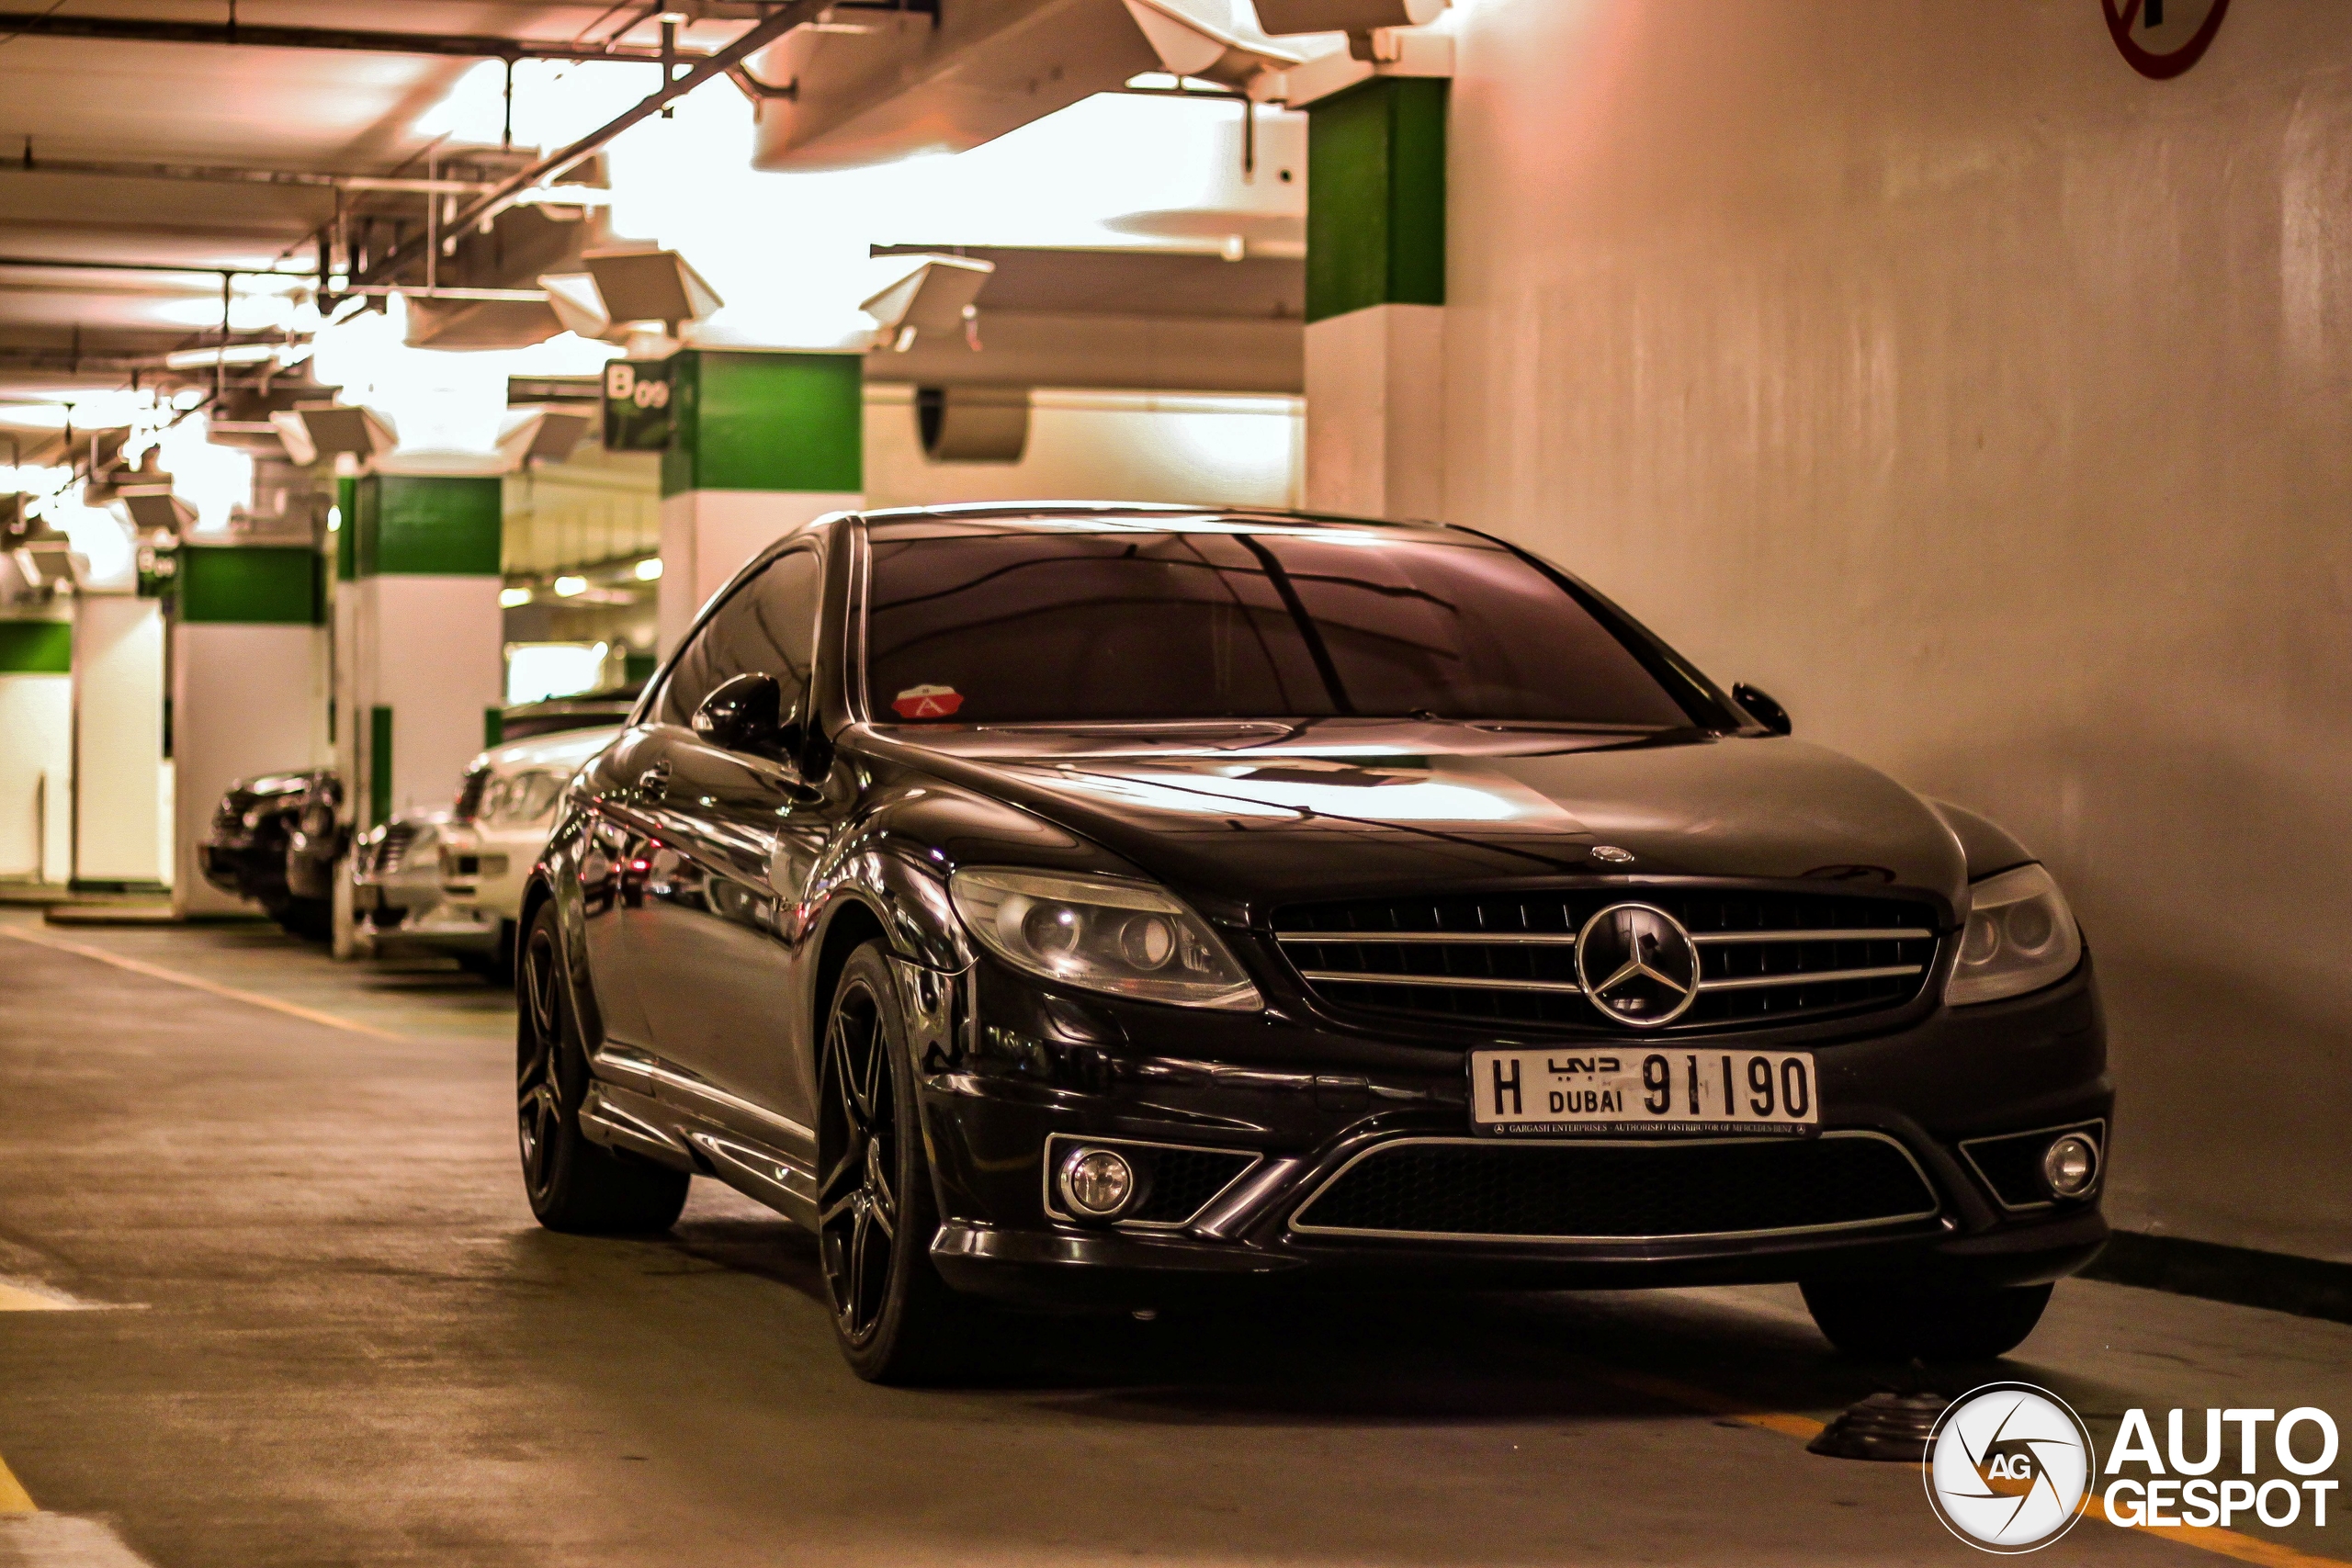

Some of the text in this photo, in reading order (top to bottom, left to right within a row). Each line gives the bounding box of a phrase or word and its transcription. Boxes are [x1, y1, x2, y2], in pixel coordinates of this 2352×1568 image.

[1548, 1057, 1620, 1082] دبي
[1493, 1058, 1522, 1115] H
[1643, 1054, 1808, 1118] 91190
[1549, 1090, 1623, 1113] DUBAI
[1509, 1123, 1550, 1133] GARGASH
[1553, 1123, 1607, 1133] ENTERPRISES
[1614, 1122, 1665, 1132] AUTHORISED
[1668, 1123, 1719, 1132] DISTRIBUTOR
[1721, 1123, 1731, 1132] OF
